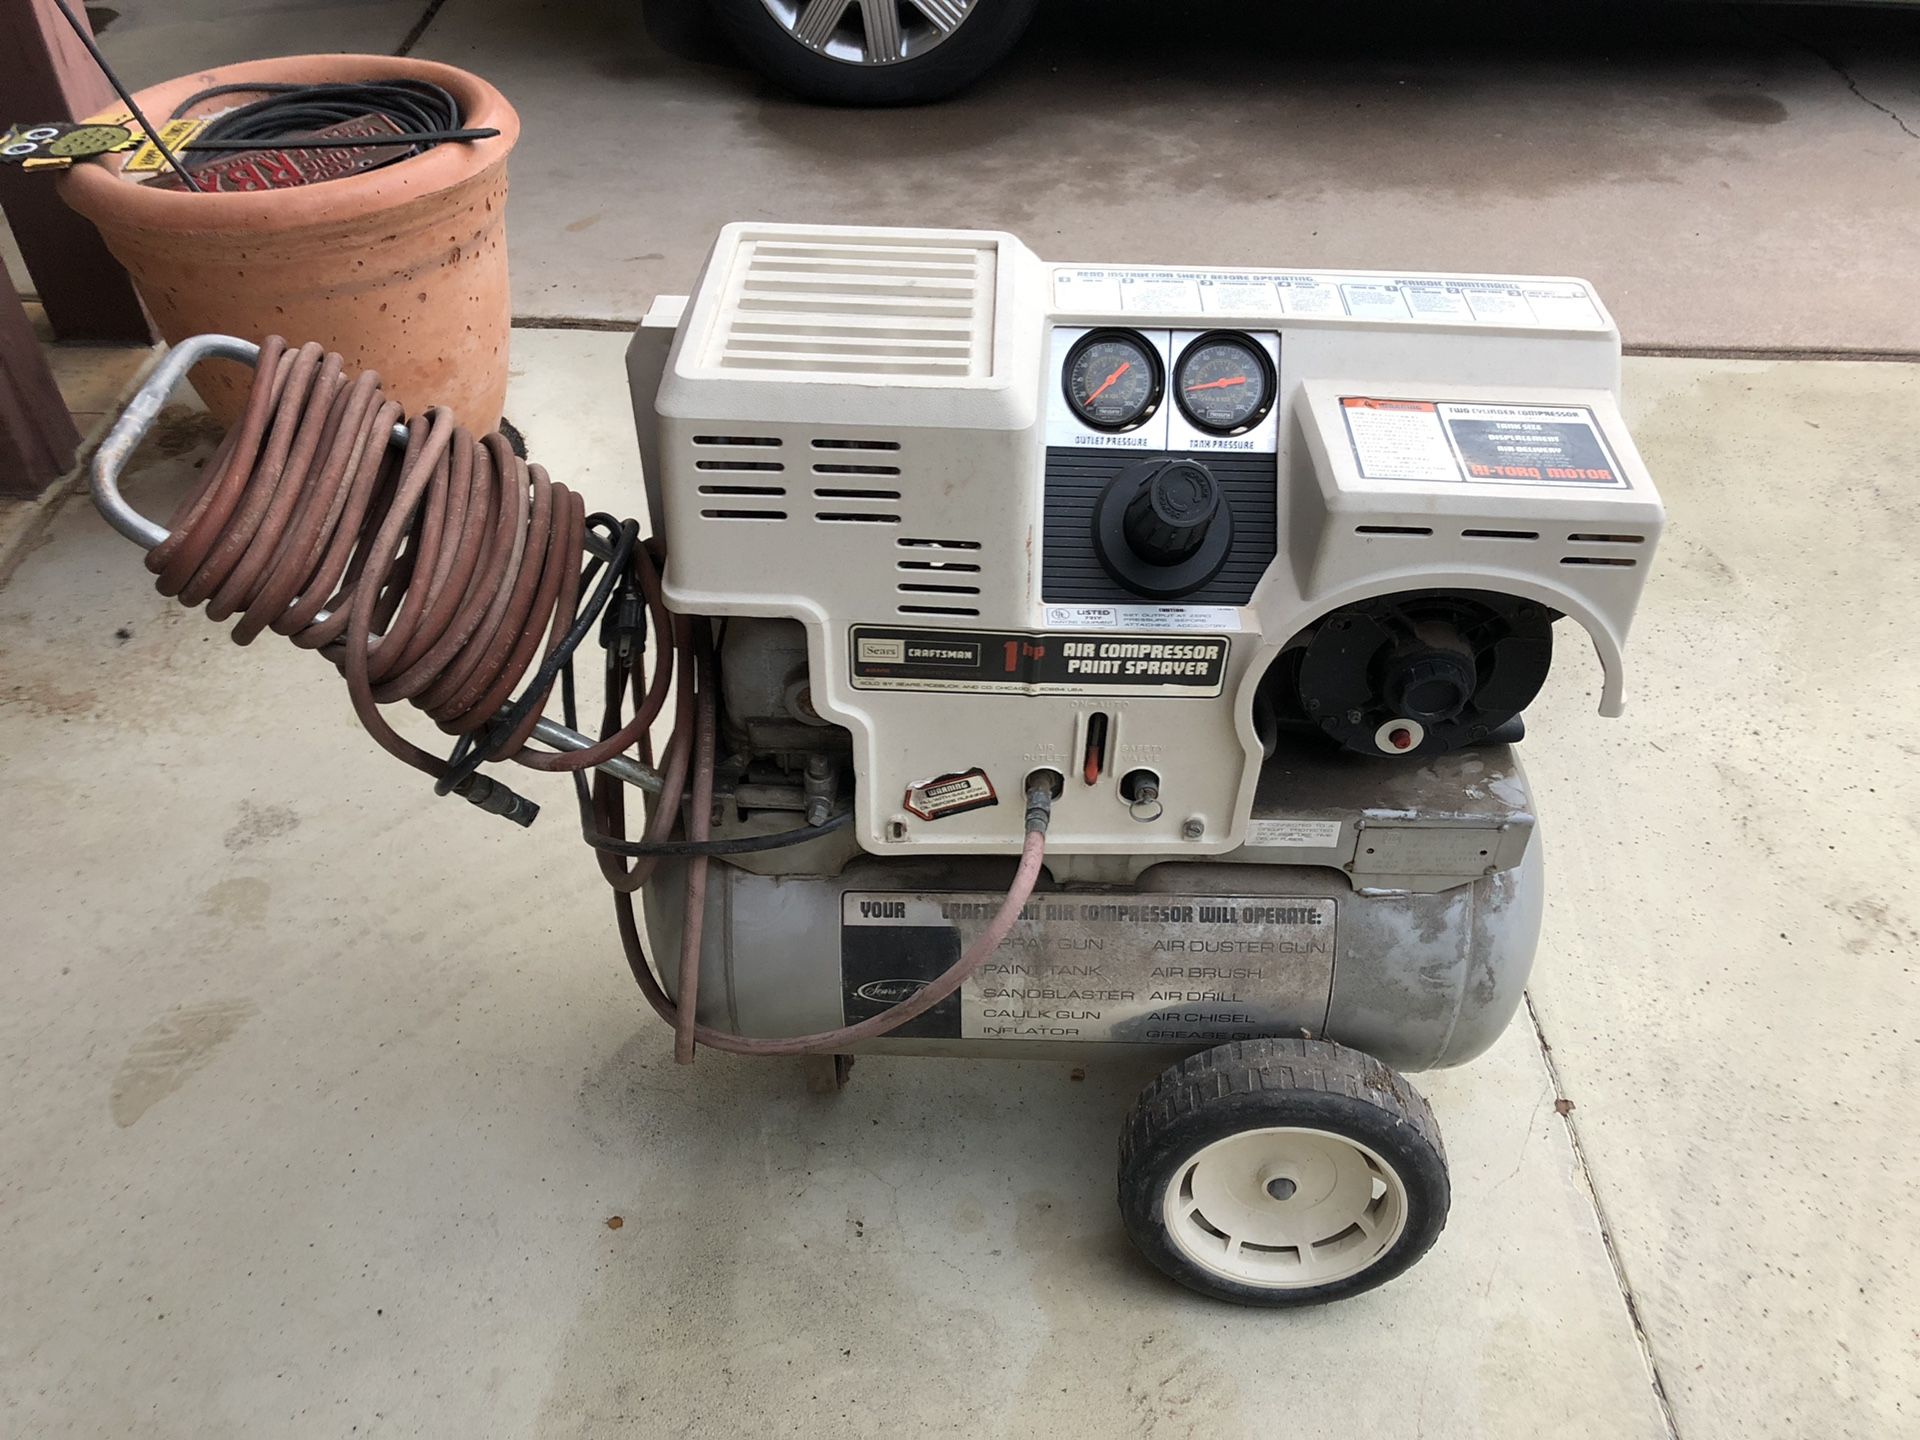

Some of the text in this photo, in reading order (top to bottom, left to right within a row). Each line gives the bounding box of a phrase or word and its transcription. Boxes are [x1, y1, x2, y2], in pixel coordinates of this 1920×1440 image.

[1074, 435, 1148, 447] OUTLET PRESSURE
[1189, 439, 1255, 450] TANK PRESSURE
[1471, 465, 1613, 480] HI-TORQ MOTOR
[866, 644, 973, 660] Sears CRAFTSMAN
[1003, 640, 1018, 672] 1
[1063, 642, 1218, 660] AIR COMPRESSOR
[1067, 659, 1209, 676] PAINT SPRAYER
[926, 781, 969, 797] WARNING
[859, 901, 906, 919] YOUR
[1045, 904, 1075, 921] AIR
[1080, 904, 1193, 923] COMPRESSOR
[1199, 905, 1238, 924] WILL
[1242, 907, 1322, 925] OPERATE:
[1057, 938, 1104, 950] GUN
[1151, 939, 1326, 954] AIR DUSTER GUN
[1049, 965, 1102, 976] TANK
[1150, 967, 1262, 979] AIR BRUSH
[983, 988, 1136, 1001] SANDBLASTER
[1149, 991, 1244, 1003] AIR DRILL
[983, 1008, 1102, 1020] CAULK GUN
[1146, 1012, 1256, 1024] AIR CHISEL
[983, 1026, 1080, 1036] INFLATOR
[1145, 1029, 1226, 1040] GREASE
